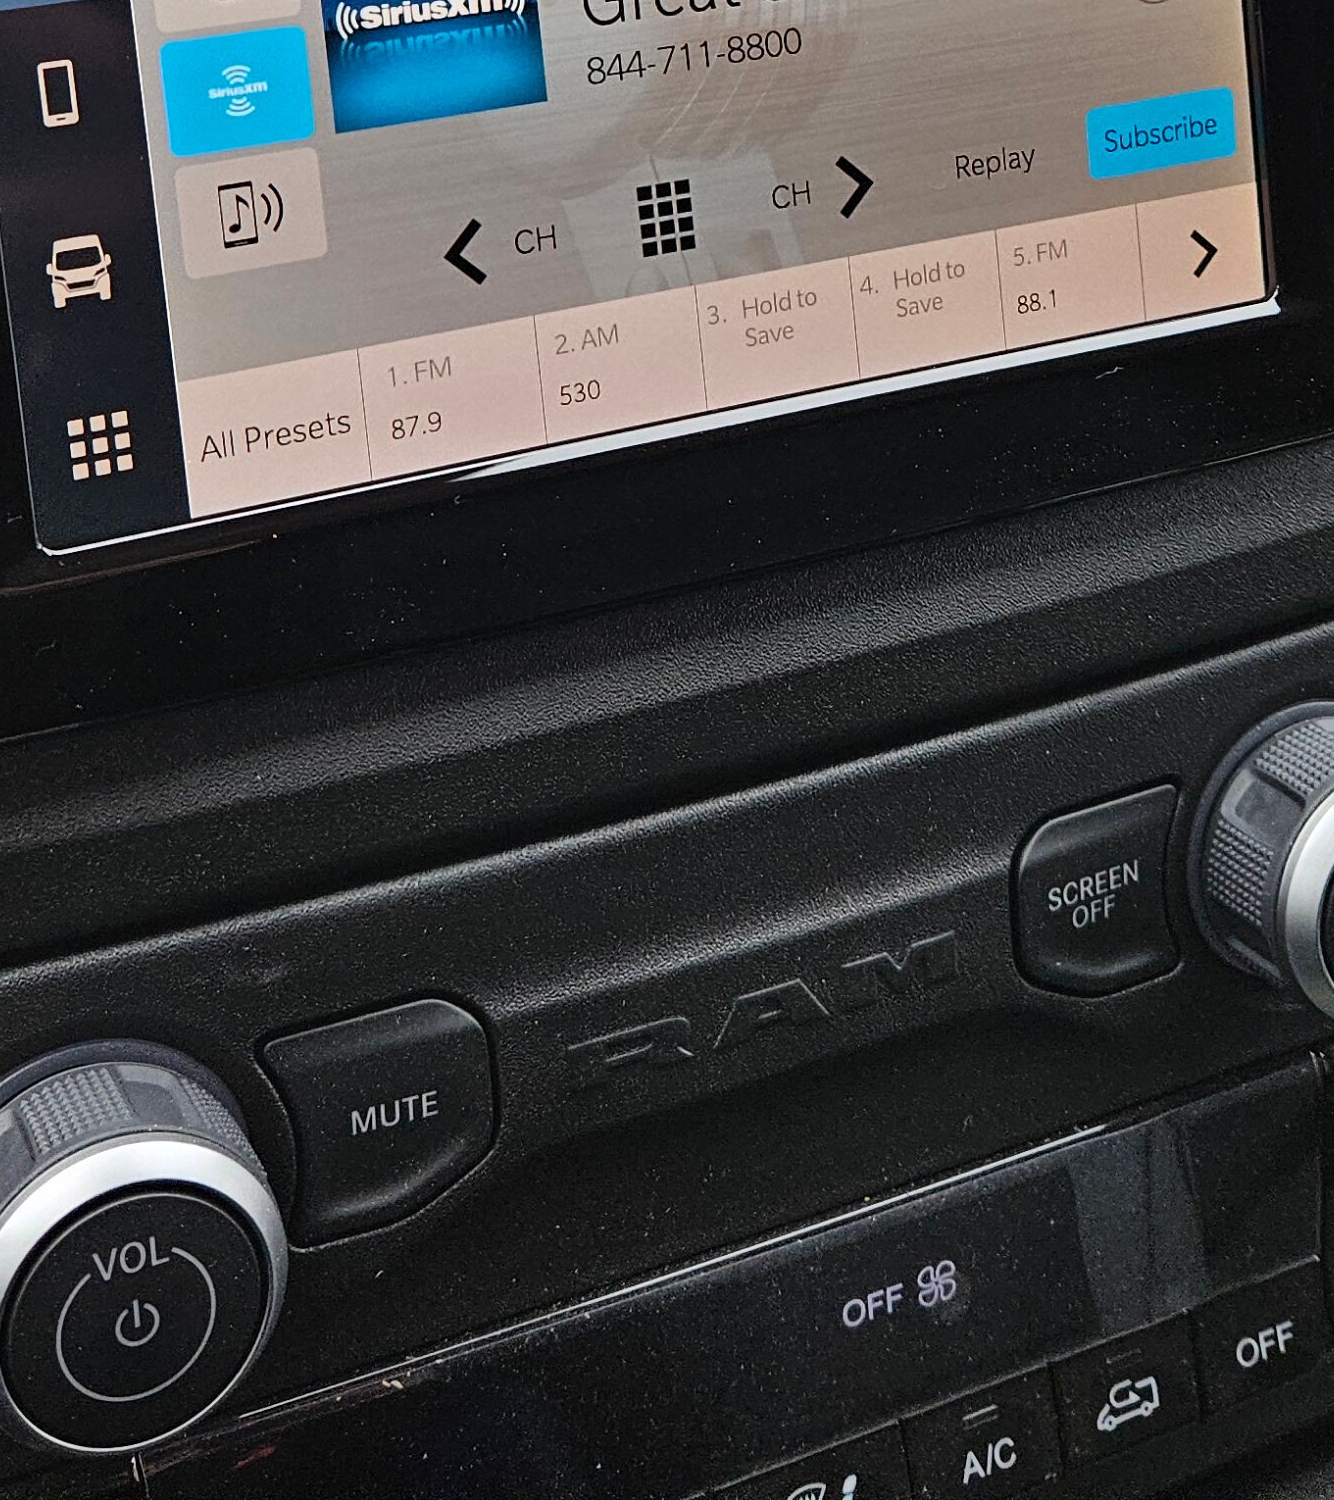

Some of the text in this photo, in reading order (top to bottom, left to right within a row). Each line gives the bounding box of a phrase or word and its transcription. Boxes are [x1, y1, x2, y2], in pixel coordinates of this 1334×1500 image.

[587, 28, 803, 85] 844-711-8800
[1104, 114, 1218, 154] Subscribe
[955, 147, 1036, 180] Replay
[771, 181, 812, 210] CH
[513, 225, 557, 255] CH
[1013, 239, 1068, 267] 5. FM
[859, 260, 966, 296] 4. Hold to
[707, 288, 817, 326] 3. Hold to
[896, 293, 944, 318] Save
[1016, 289, 1058, 315] 88.1
[554, 325, 620, 355] 2. AM
[745, 321, 794, 348] Save
[388, 357, 453, 387] 1. FM
[559, 380, 601, 407] 530
[200, 412, 352, 463] All Presets
[391, 412, 443, 440] 87.9
[1047, 859, 1140, 912] SCREEN
[1072, 899, 1116, 930] OFF
[566, 928, 963, 1086] RAM
[350, 1090, 440, 1136] MUTE
[91, 1236, 170, 1282] VOL
[842, 1282, 905, 1328] OFF
[1235, 1321, 1295, 1368] OFF
[962, 1437, 1018, 1484] A/C
